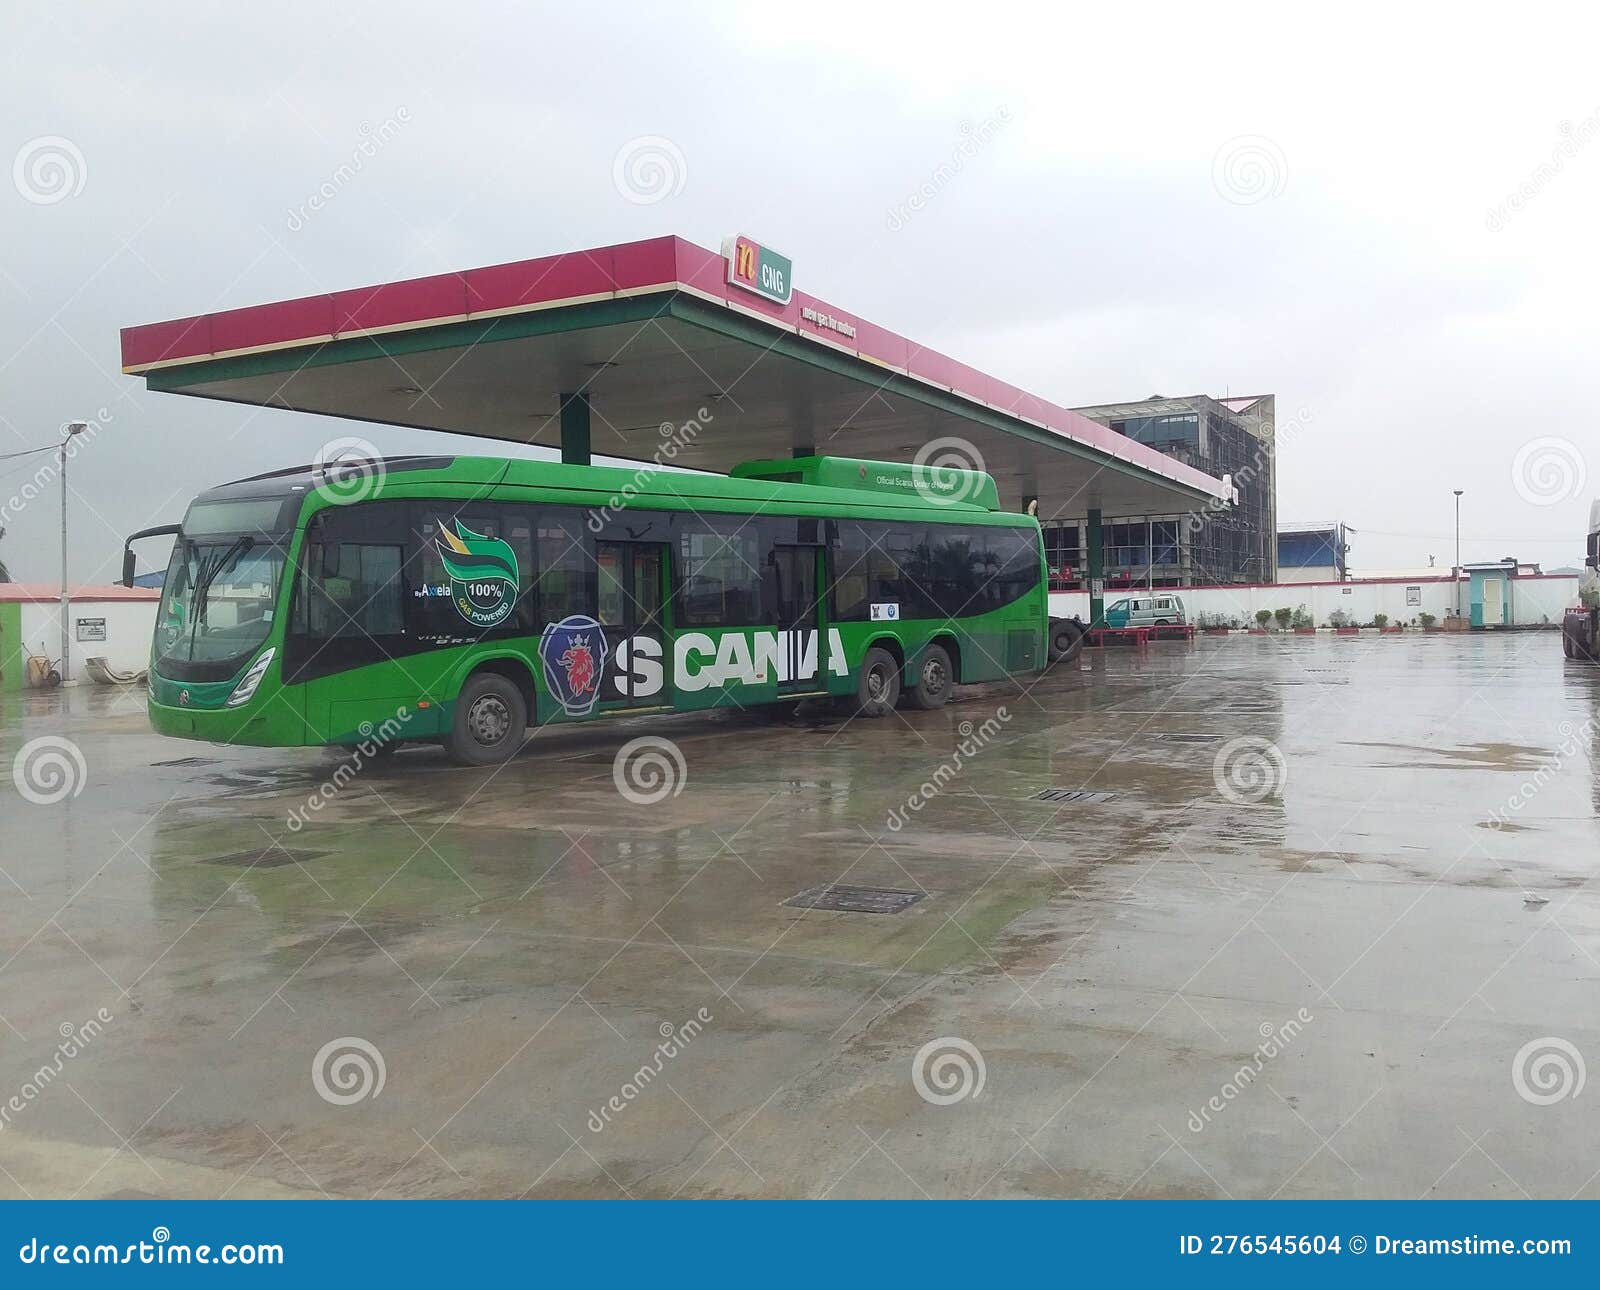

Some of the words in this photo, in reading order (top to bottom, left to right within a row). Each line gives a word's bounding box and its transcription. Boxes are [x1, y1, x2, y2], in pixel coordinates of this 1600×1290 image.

[762, 263, 784, 294] CNG
[876, 475, 895, 485] Official
[895, 477, 913, 488] Scania
[469, 583, 502, 598] 100%
[459, 598, 472, 616] GAS
[471, 602, 509, 622] POWERED
[614, 628, 849, 698] SCANIA
